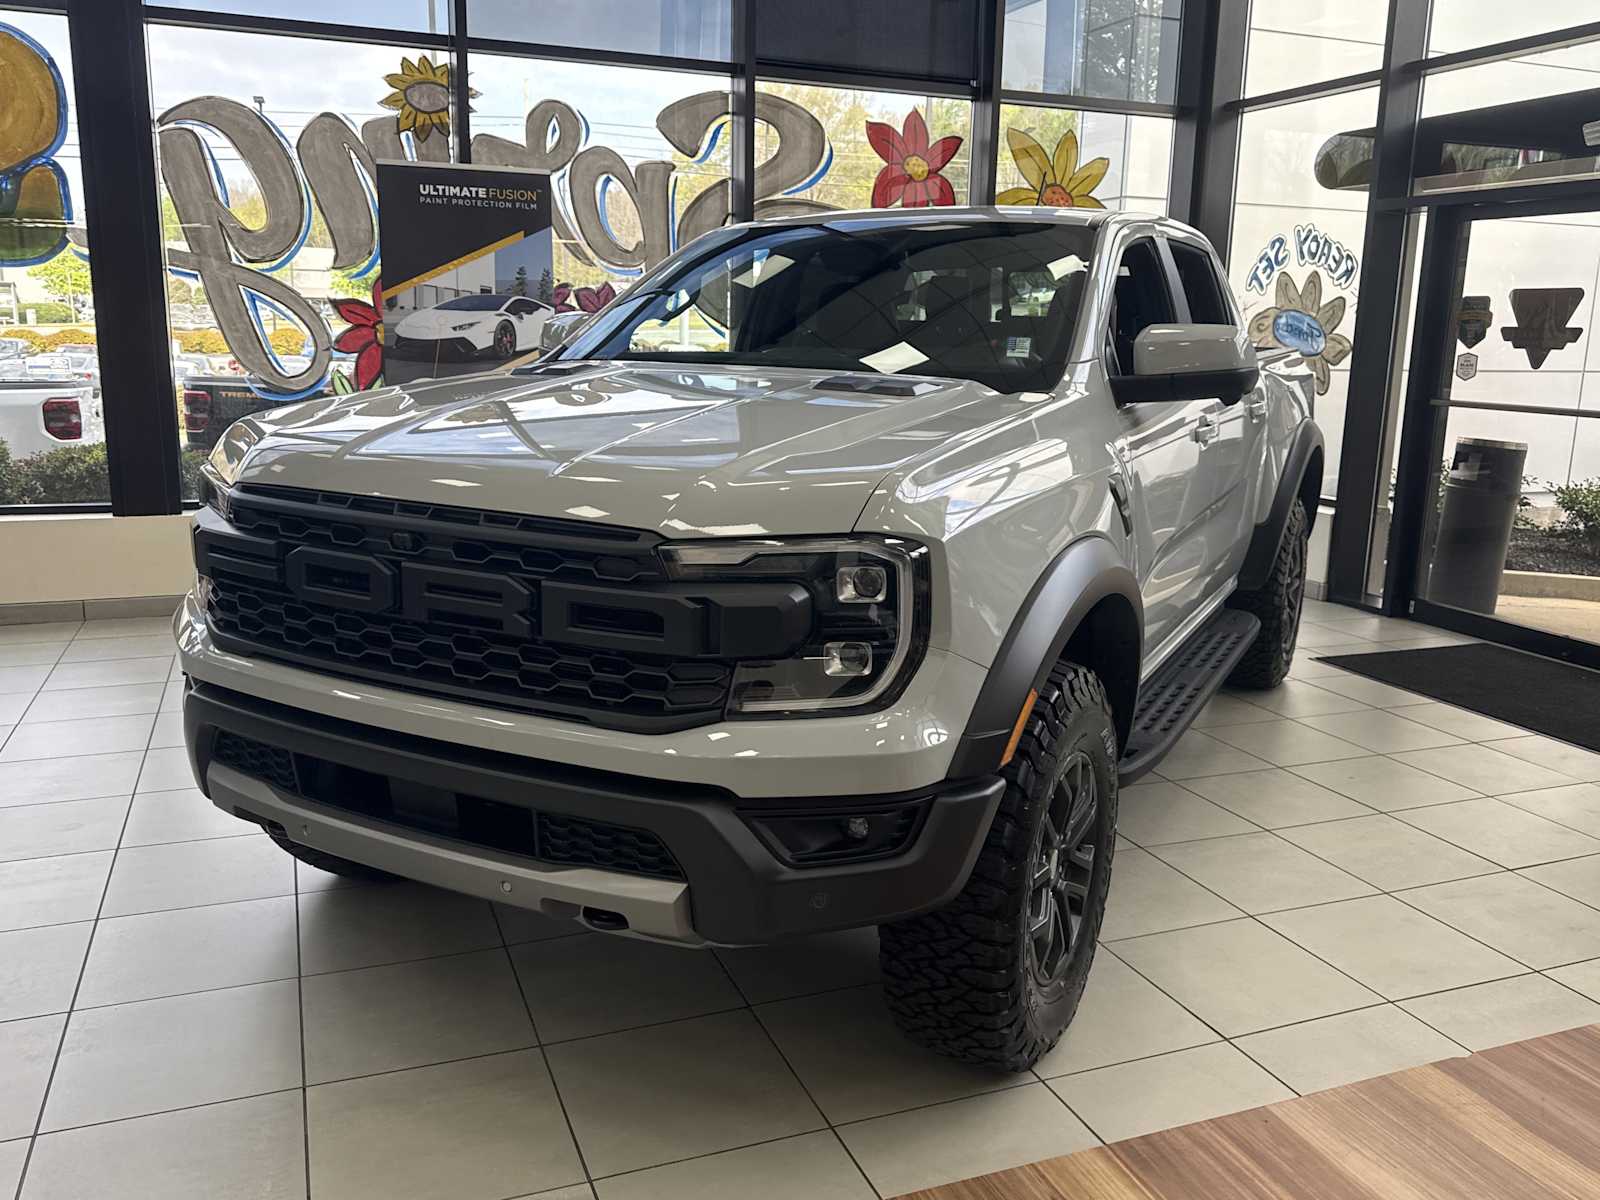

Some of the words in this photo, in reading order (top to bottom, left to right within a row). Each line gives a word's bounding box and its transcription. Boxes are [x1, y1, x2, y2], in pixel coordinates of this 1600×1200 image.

[419, 184, 487, 198] ULTIMATE
[419, 196, 448, 205] PAINT
[452, 198, 512, 209] PROTECTION
[516, 202, 538, 210] FILM
[195, 526, 712, 657] FORD
